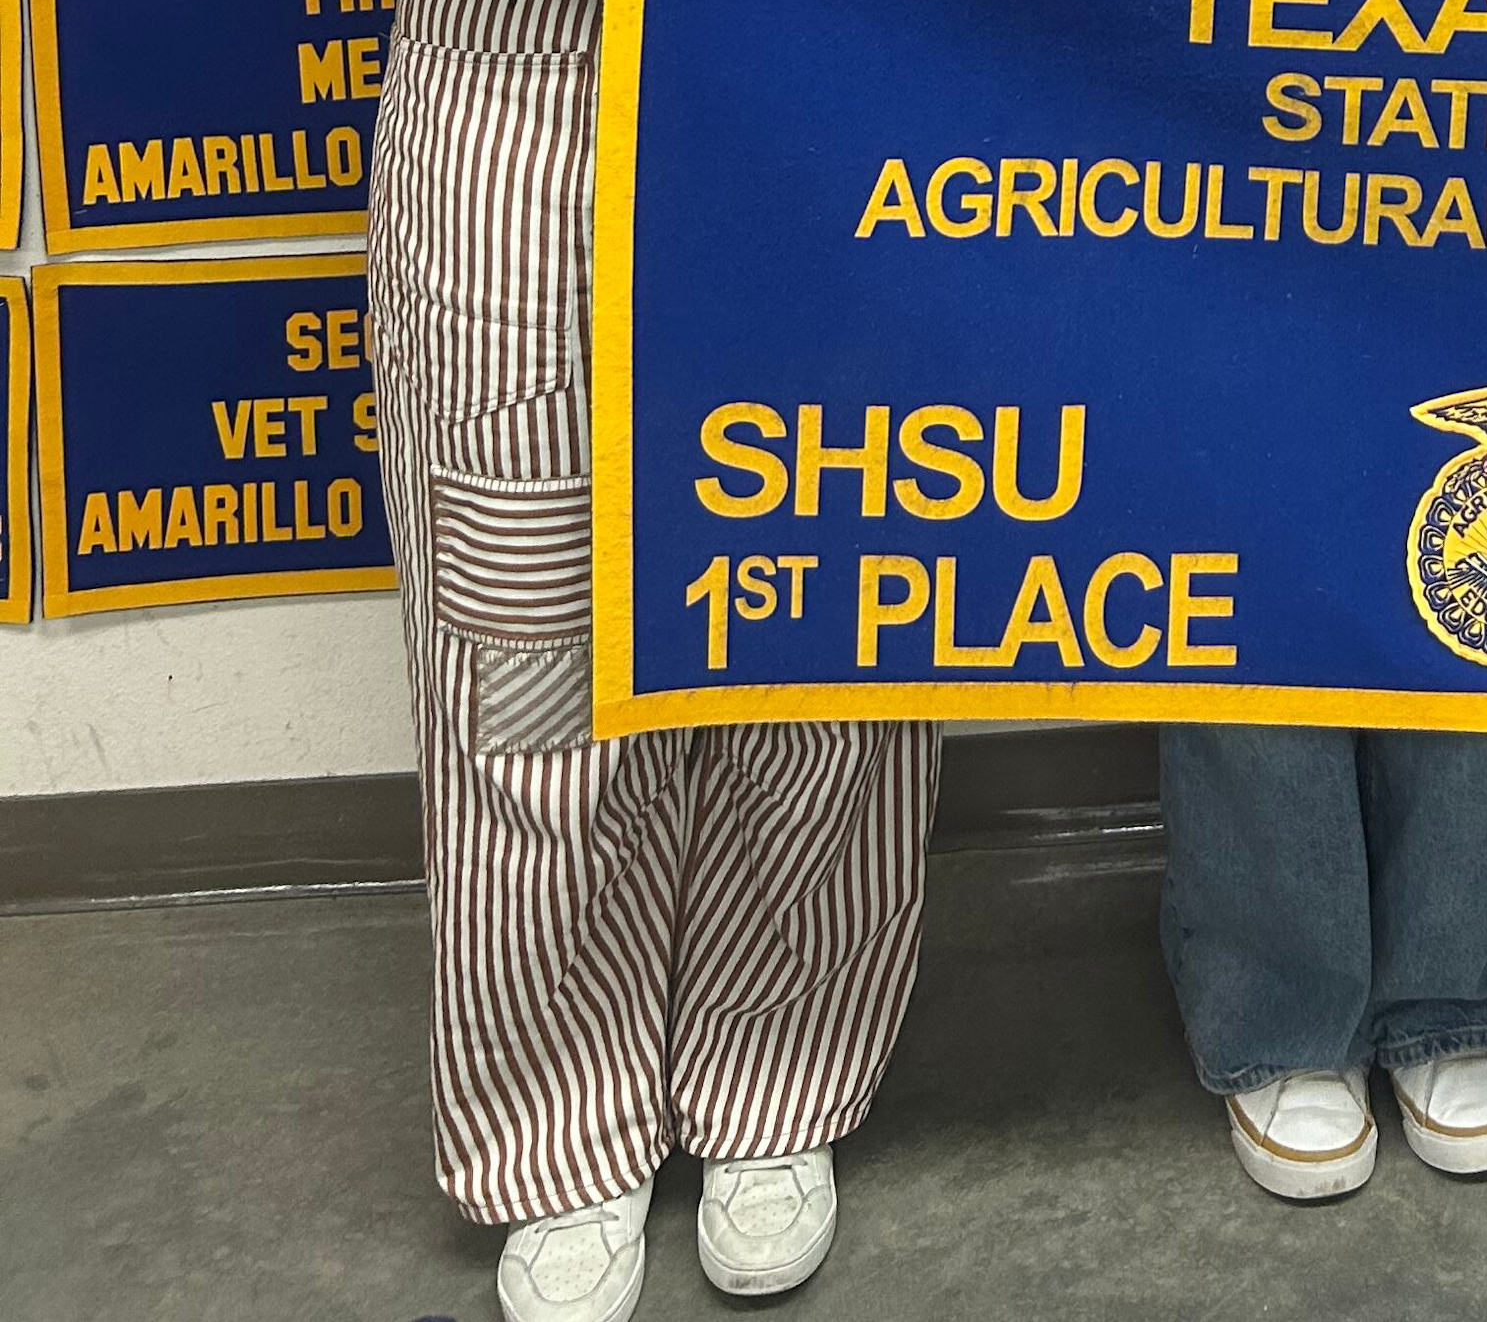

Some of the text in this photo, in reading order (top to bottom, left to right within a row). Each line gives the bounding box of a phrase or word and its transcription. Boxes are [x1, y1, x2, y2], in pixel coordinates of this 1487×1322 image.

[83, 127, 362, 205] AMARILLO
[212, 396, 327, 459] VET
[695, 402, 1085, 521] SHSU
[78, 478, 362, 555] AMARILLO
[686, 553, 1238, 669] 1ST PLACE
